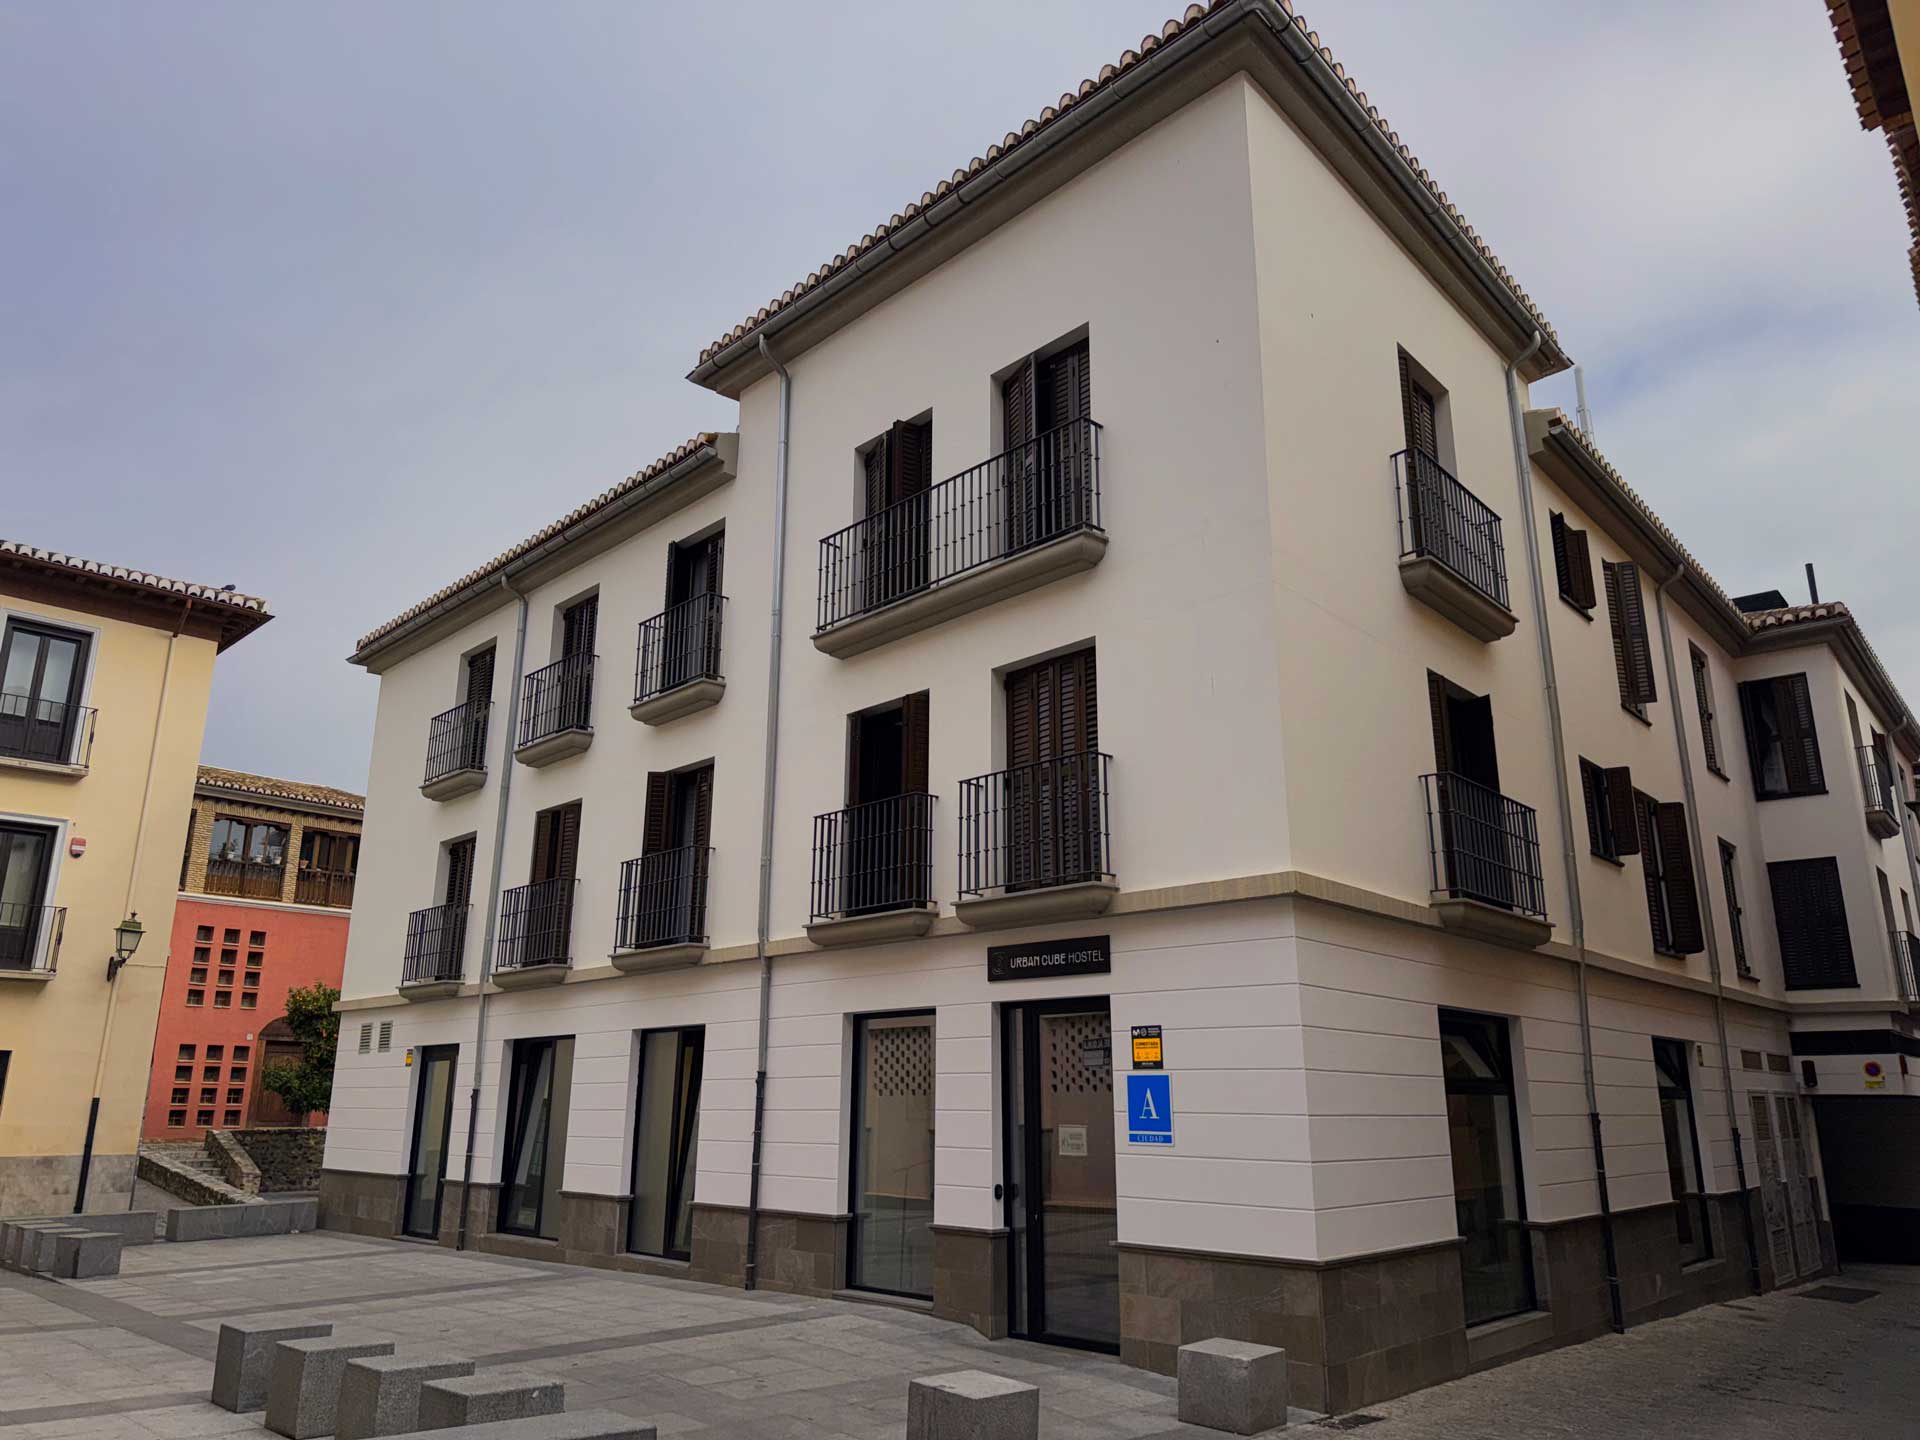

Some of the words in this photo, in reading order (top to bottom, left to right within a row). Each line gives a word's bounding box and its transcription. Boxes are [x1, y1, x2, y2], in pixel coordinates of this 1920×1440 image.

[1010, 955, 1040, 969] URBAN
[1041, 952, 1066, 966] CUBE
[1068, 950, 1104, 963] HOSTEL
[1139, 1087, 1160, 1119] A
